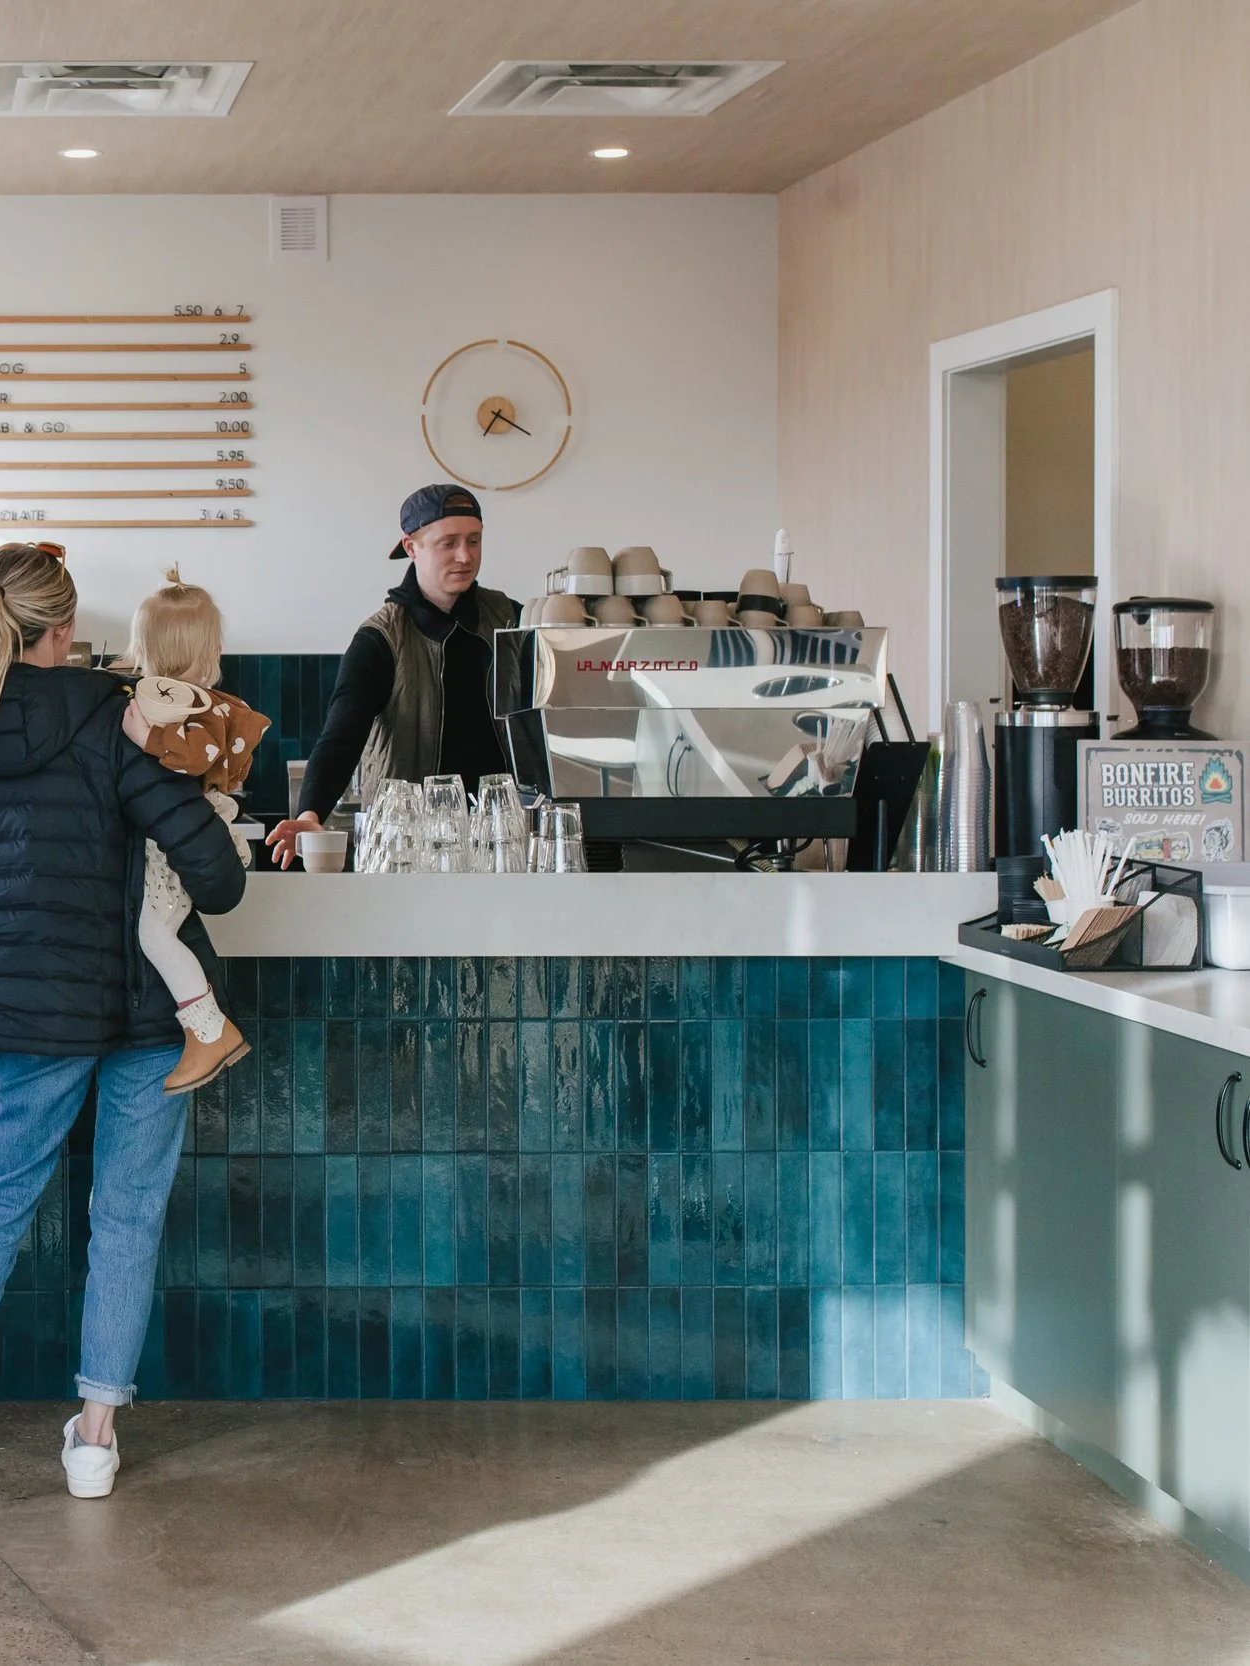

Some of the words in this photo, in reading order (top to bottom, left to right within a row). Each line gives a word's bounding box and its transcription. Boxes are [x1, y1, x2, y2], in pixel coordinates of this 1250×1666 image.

[174, 304, 203, 316] 5.50
[214, 304, 223, 316] 6
[236, 304, 244, 316] 7
[219, 333, 240, 344] 2.9
[239, 363, 247, 374] 5
[219, 391, 248, 403] 2.00
[23, 422, 34, 433] &
[42, 422, 66, 433] GO
[215, 421, 250, 433] 10.00
[216, 450, 245, 462] 5.95
[215, 479, 246, 490] 9.50
[200, 509, 208, 520] 3
[216, 509, 225, 520] 4
[233, 509, 241, 520] 5
[1100, 761, 1196, 787] BONFIRE
[1102, 786, 1196, 808] BURRITOS
[1122, 812, 1158, 826] SOLD
[1162, 813, 1206, 826] HERE!
